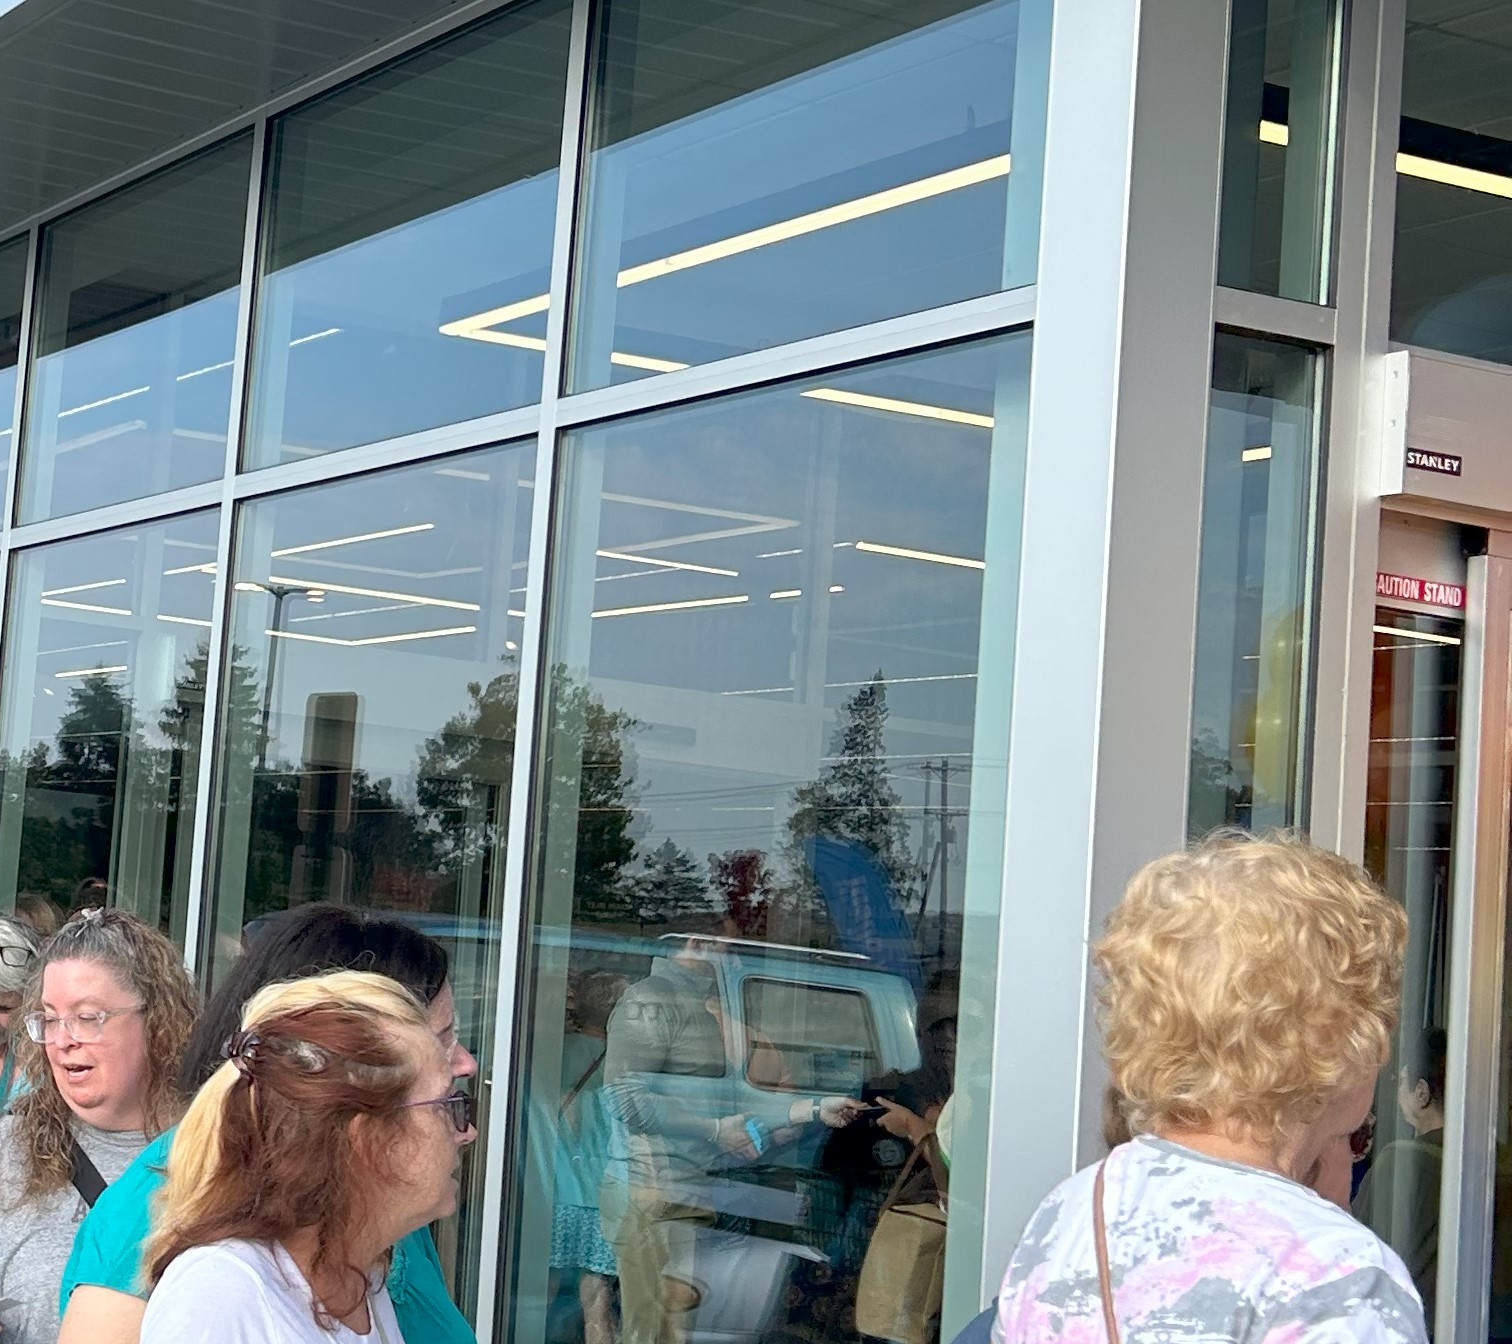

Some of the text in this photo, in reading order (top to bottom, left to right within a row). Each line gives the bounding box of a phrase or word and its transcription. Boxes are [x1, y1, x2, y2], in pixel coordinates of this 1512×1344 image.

[1407, 451, 1460, 472] STANLEY
[1376, 573, 1462, 607] AUTION STAND
